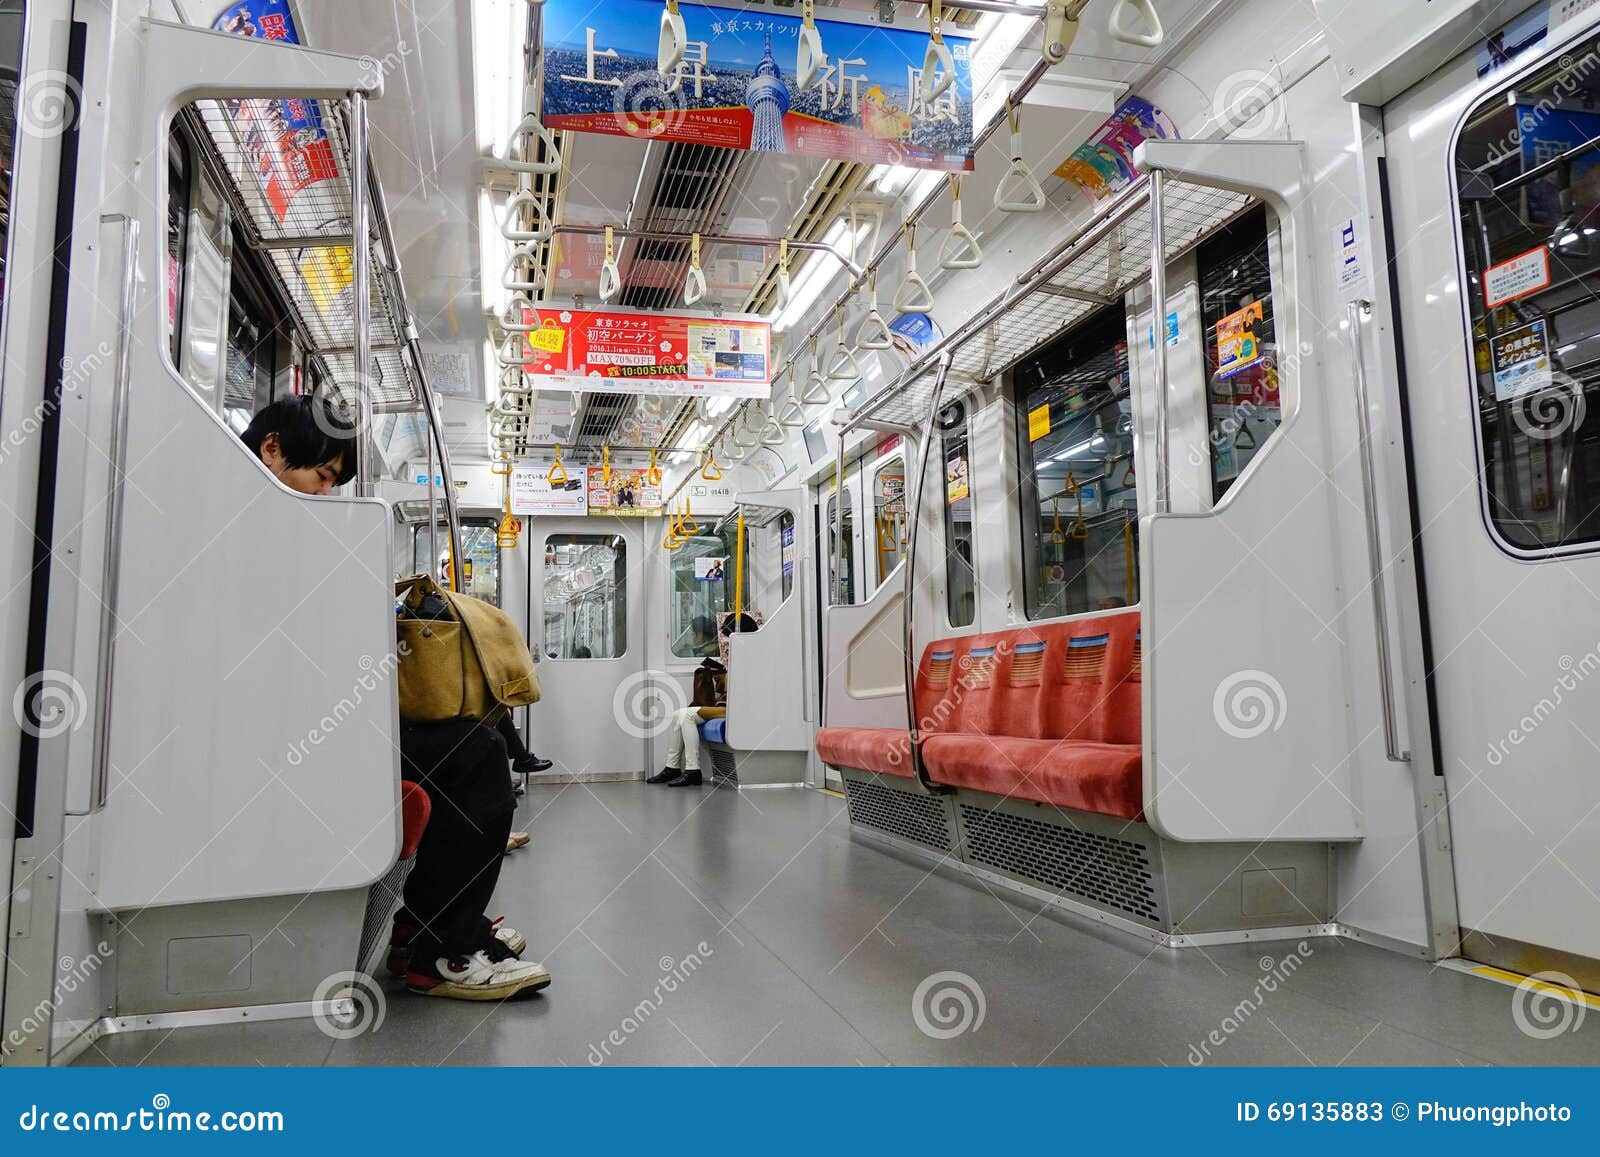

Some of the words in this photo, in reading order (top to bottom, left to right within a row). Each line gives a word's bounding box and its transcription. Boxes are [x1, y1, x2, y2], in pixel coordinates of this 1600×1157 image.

[710, 19, 799, 37] 東京スカイツリ
